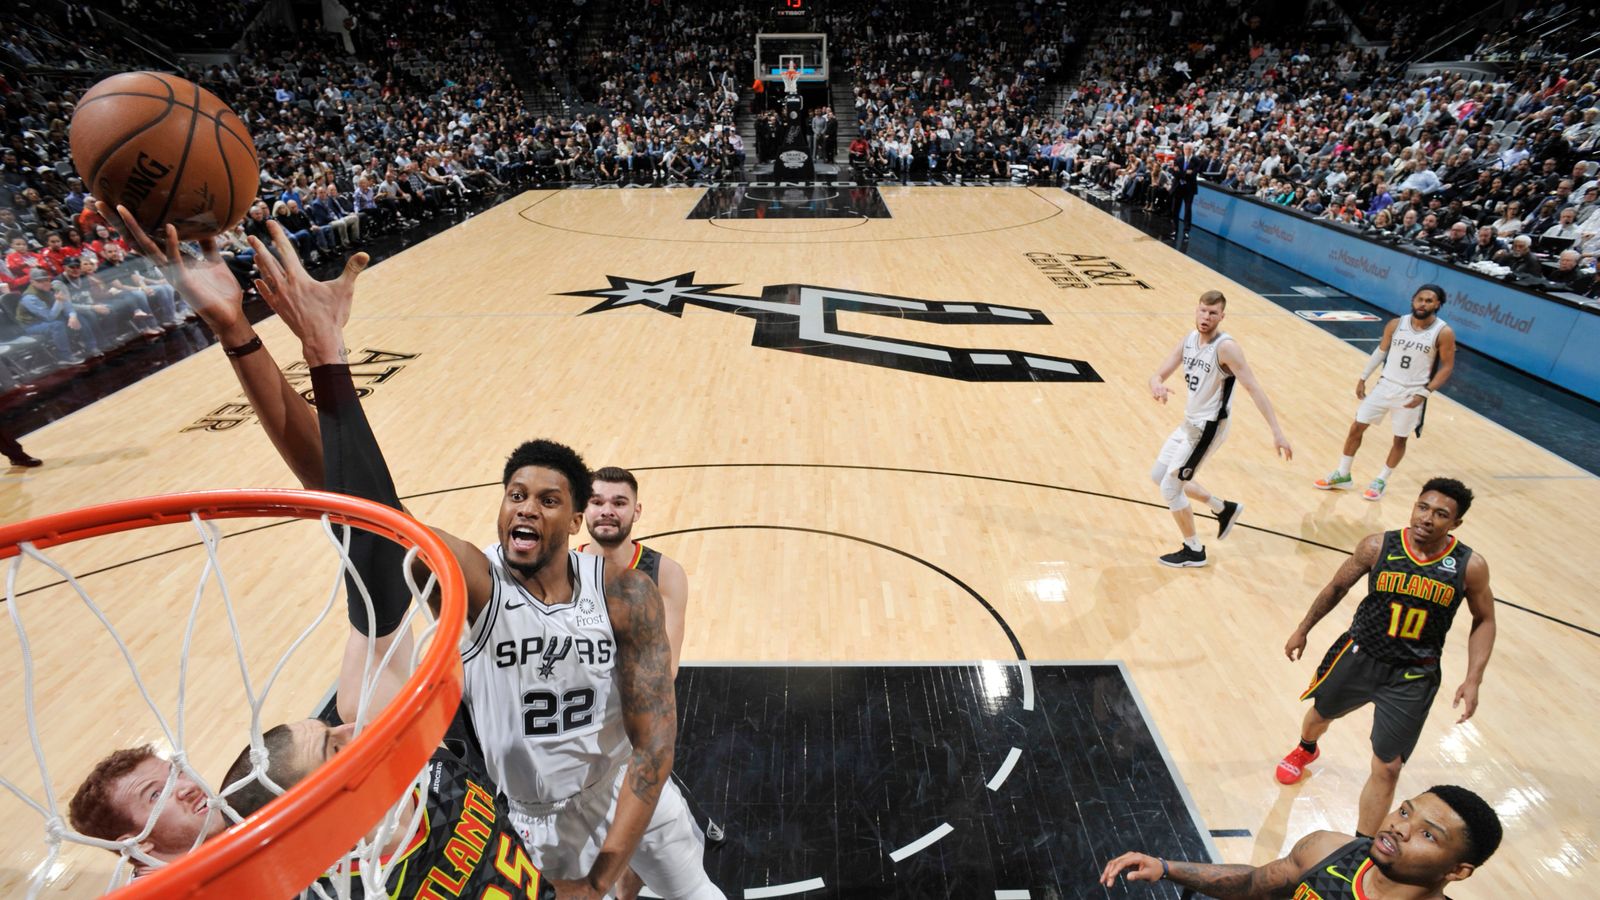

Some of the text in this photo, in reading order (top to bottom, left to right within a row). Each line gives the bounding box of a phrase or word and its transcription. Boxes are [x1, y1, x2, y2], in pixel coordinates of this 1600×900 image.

[1023, 251, 1092, 289] CENTER
[1056, 252, 1156, 291] AT&T
[1337, 249, 1392, 280] MassMutual
[1453, 290, 1536, 335] MassMutual
[1183, 356, 1212, 374] SPURS
[1392, 338, 1432, 355] SPURS
[1400, 355, 1412, 370] 8
[1185, 373, 1200, 392] 42
[1376, 571, 1455, 608] ATLANTA
[575, 613, 605, 627] Frost
[1388, 601, 1428, 640] 10
[496, 635, 612, 676] SPURS
[521, 687, 598, 739] 22
[413, 778, 496, 900] TLANTA
